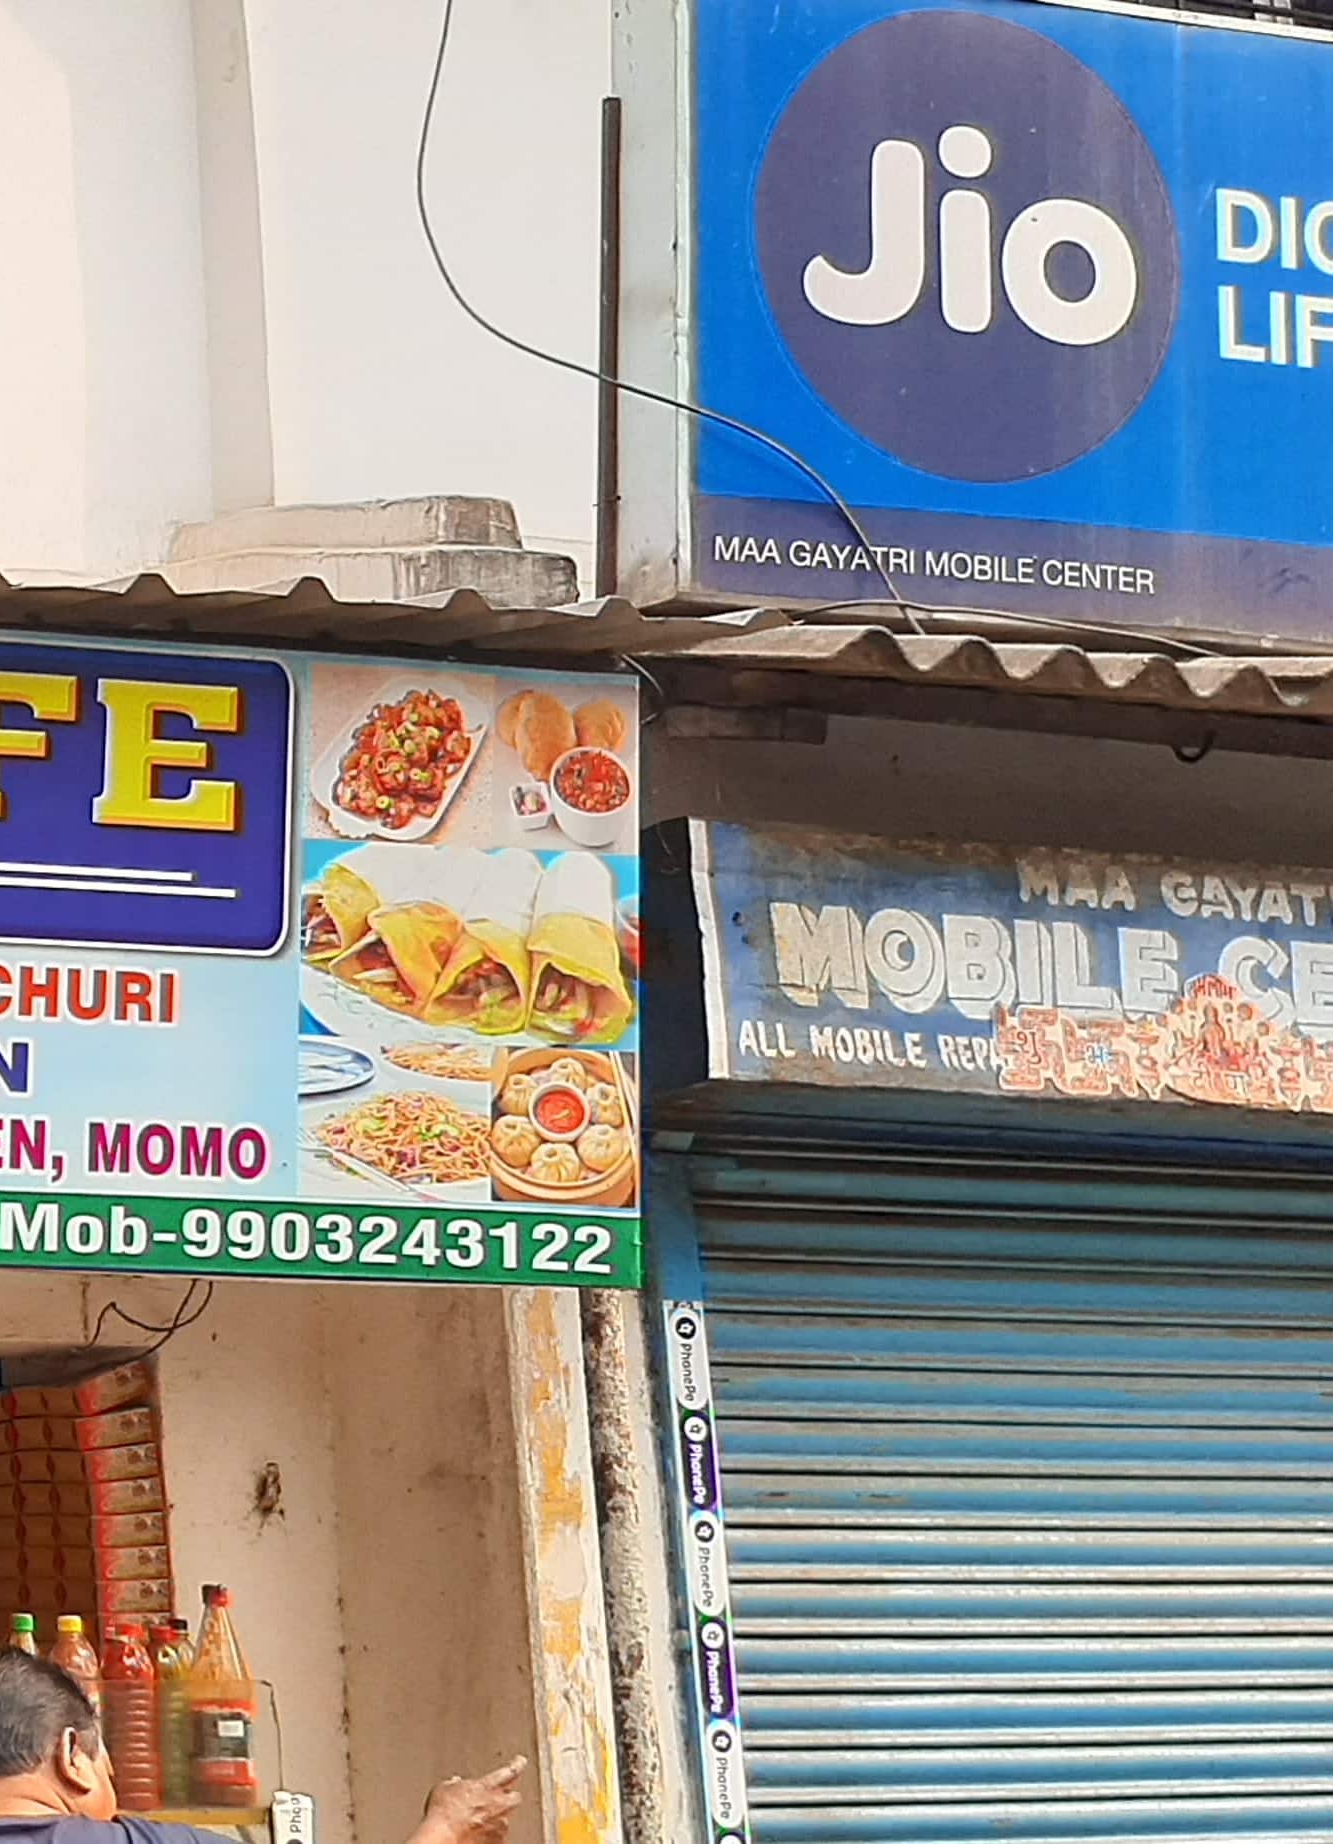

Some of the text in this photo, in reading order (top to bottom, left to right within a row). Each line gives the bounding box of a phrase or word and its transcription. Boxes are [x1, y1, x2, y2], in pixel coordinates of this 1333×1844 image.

[803, 125, 1137, 346] Jio
[713, 535, 1155, 595] MAA GAYATRI MOBILE CENTER
[1017, 858, 1332, 926] MAA GAYAT
[770, 901, 1181, 1018] MOBILE
[738, 1019, 797, 1059] ALL
[810, 1027, 926, 1069] MOBILE
[88, 1124, 267, 1178] MOMO
[680, 1343, 697, 1402] PhonePe
[689, 1443, 707, 1505] PhonePe
[697, 1546, 714, 1607] PhonePe
[705, 1650, 724, 1713] PhonePe
[716, 1756, 732, 1819] PhonePe
